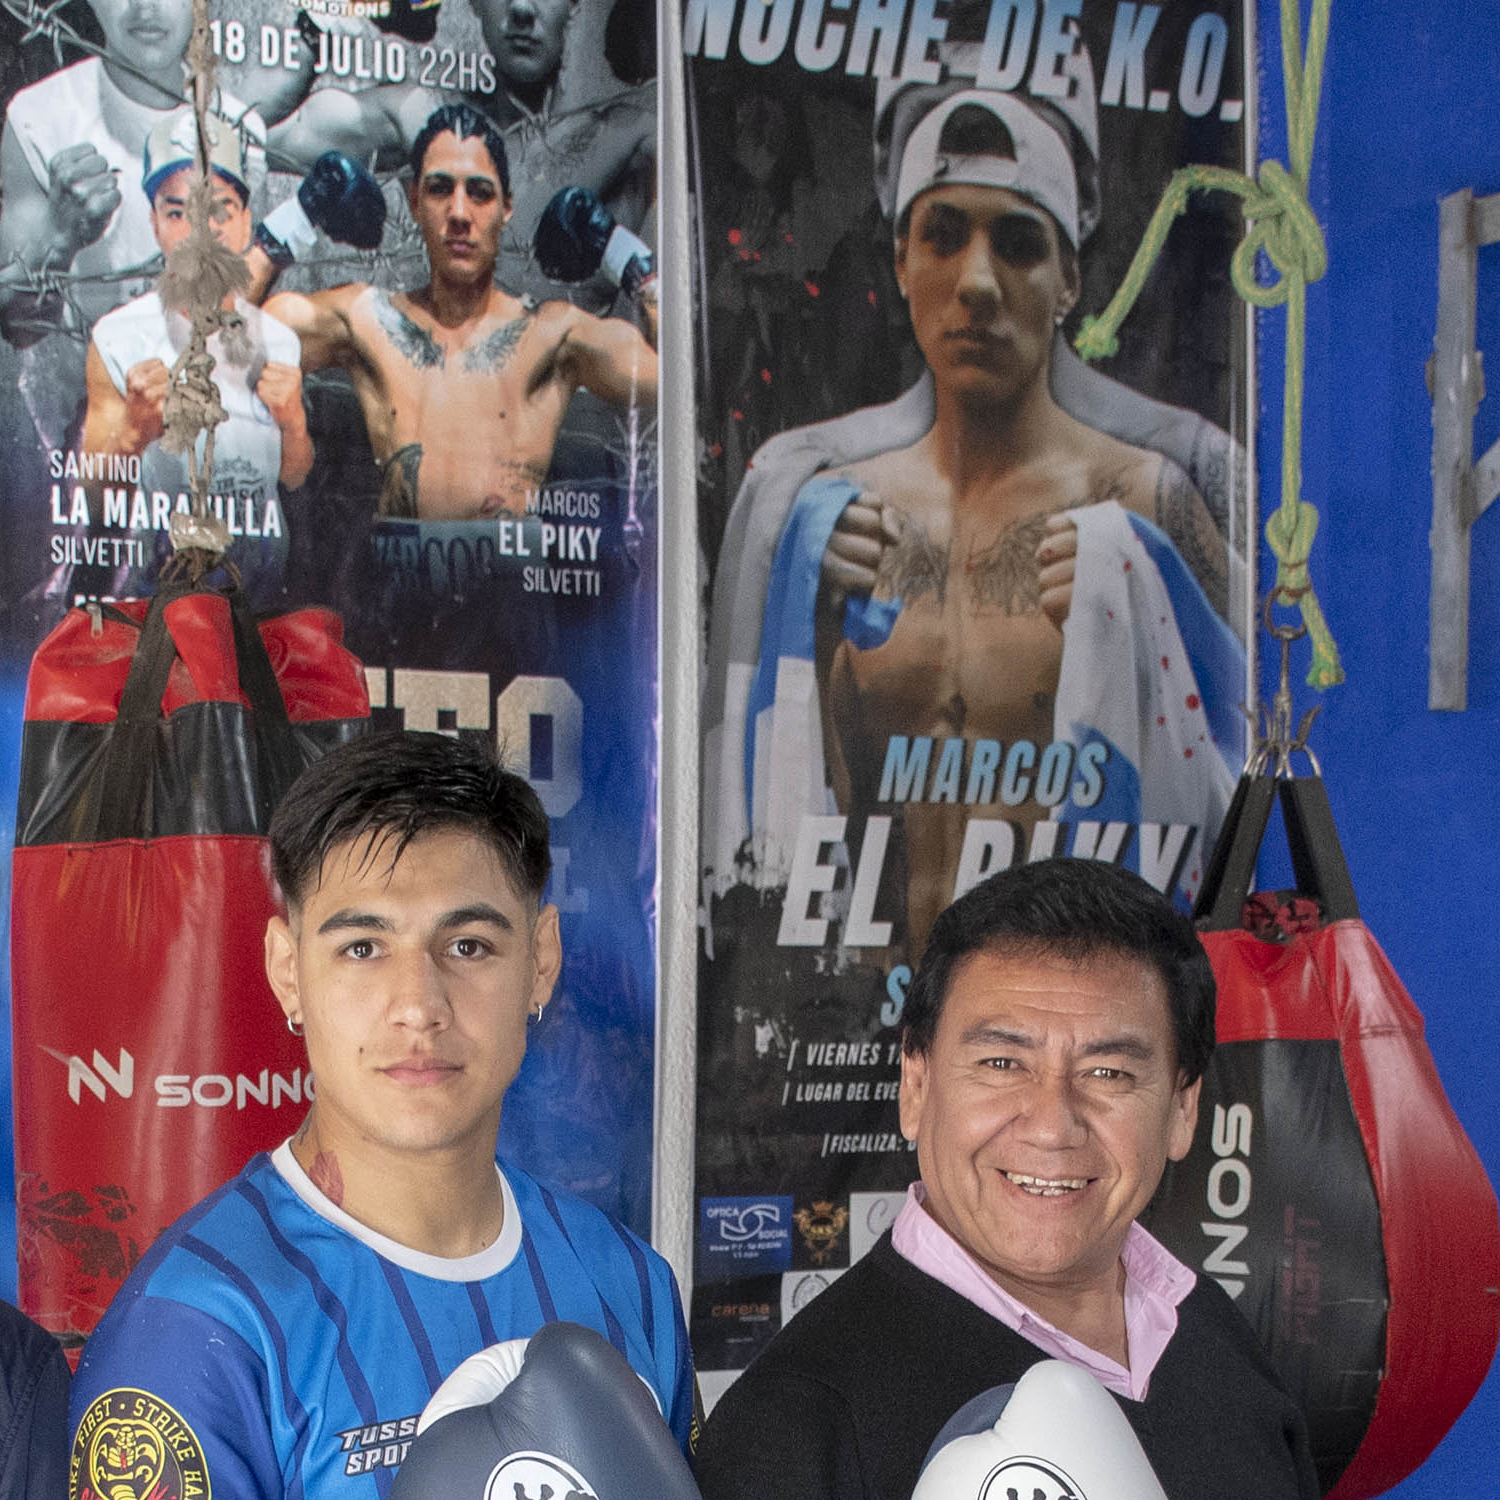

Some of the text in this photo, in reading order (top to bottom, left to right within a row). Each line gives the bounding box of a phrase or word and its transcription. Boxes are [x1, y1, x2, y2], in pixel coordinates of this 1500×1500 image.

[211, 19, 497, 94] 18 DE JULIO 22HS
[976, 0, 1083, 97] DE
[1100, 2, 1244, 121] K.O.
[50, 449, 141, 483] SANTINO
[51, 484, 282, 538] LA MARAILLA
[525, 488, 600, 519] MARCOS
[50, 535, 144, 567] SILVETTI
[500, 520, 602, 562] EL PIKY
[522, 565, 600, 597] SILVETTI
[877, 735, 1109, 807] MARCOS
[776, 815, 894, 947] EL
[806, 1042, 882, 1066] VIERNES
[795, 1082, 843, 1102] LUGAR
[846, 1082, 871, 1101] DEL
[78, 1398, 113, 1448] FIRST
[133, 1397, 197, 1462] STRIKE
[337, 1416, 418, 1450] TUSS
